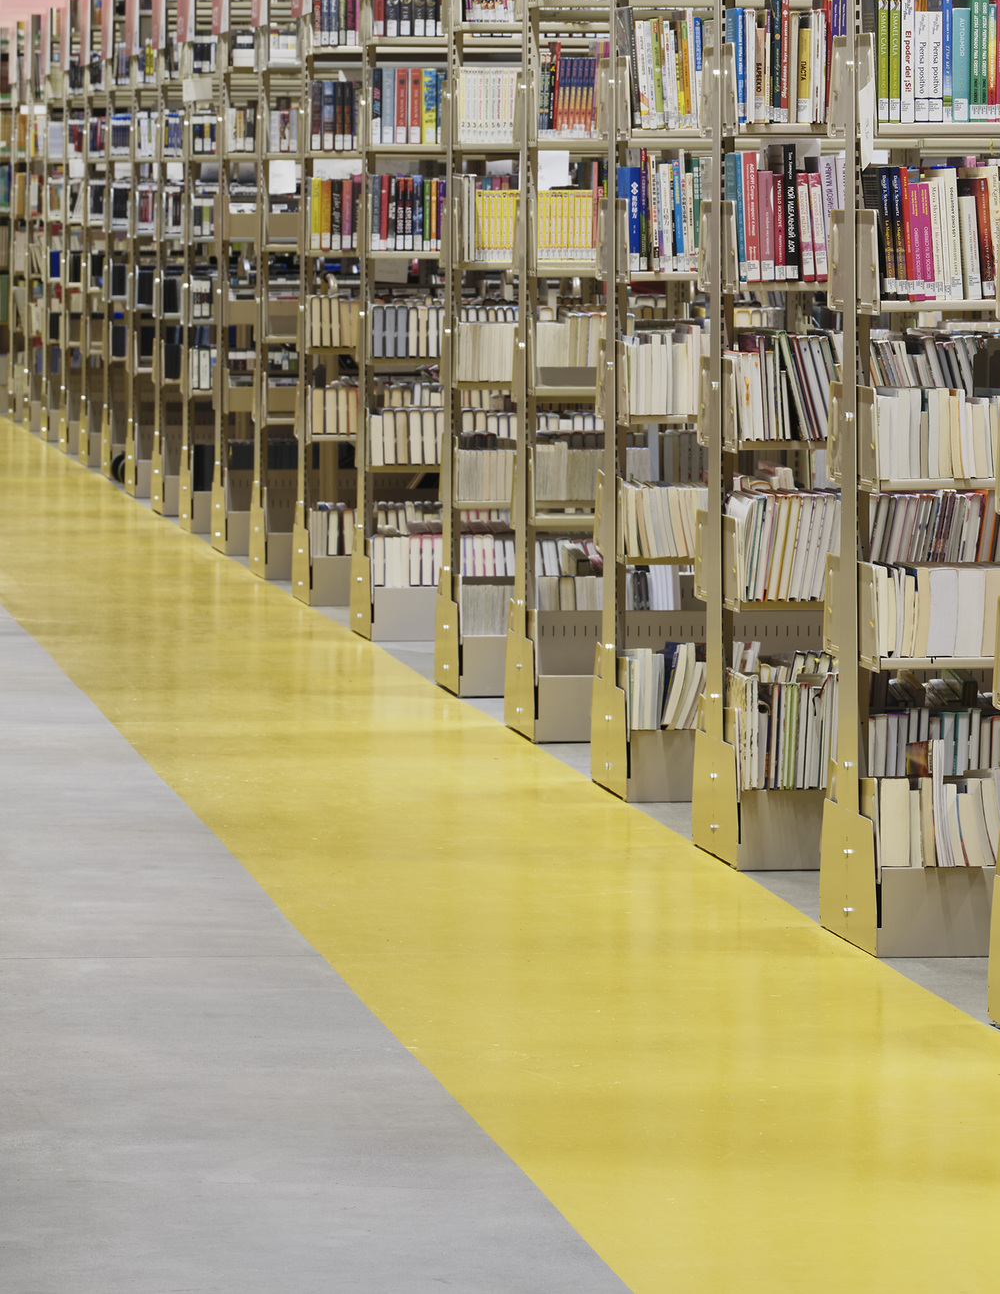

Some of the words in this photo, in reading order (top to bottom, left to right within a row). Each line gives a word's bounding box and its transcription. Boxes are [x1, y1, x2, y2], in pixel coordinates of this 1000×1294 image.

[905, 30, 912, 38] El
[904, 40, 912, 64] poder
[919, 41, 927, 64] Piensa
